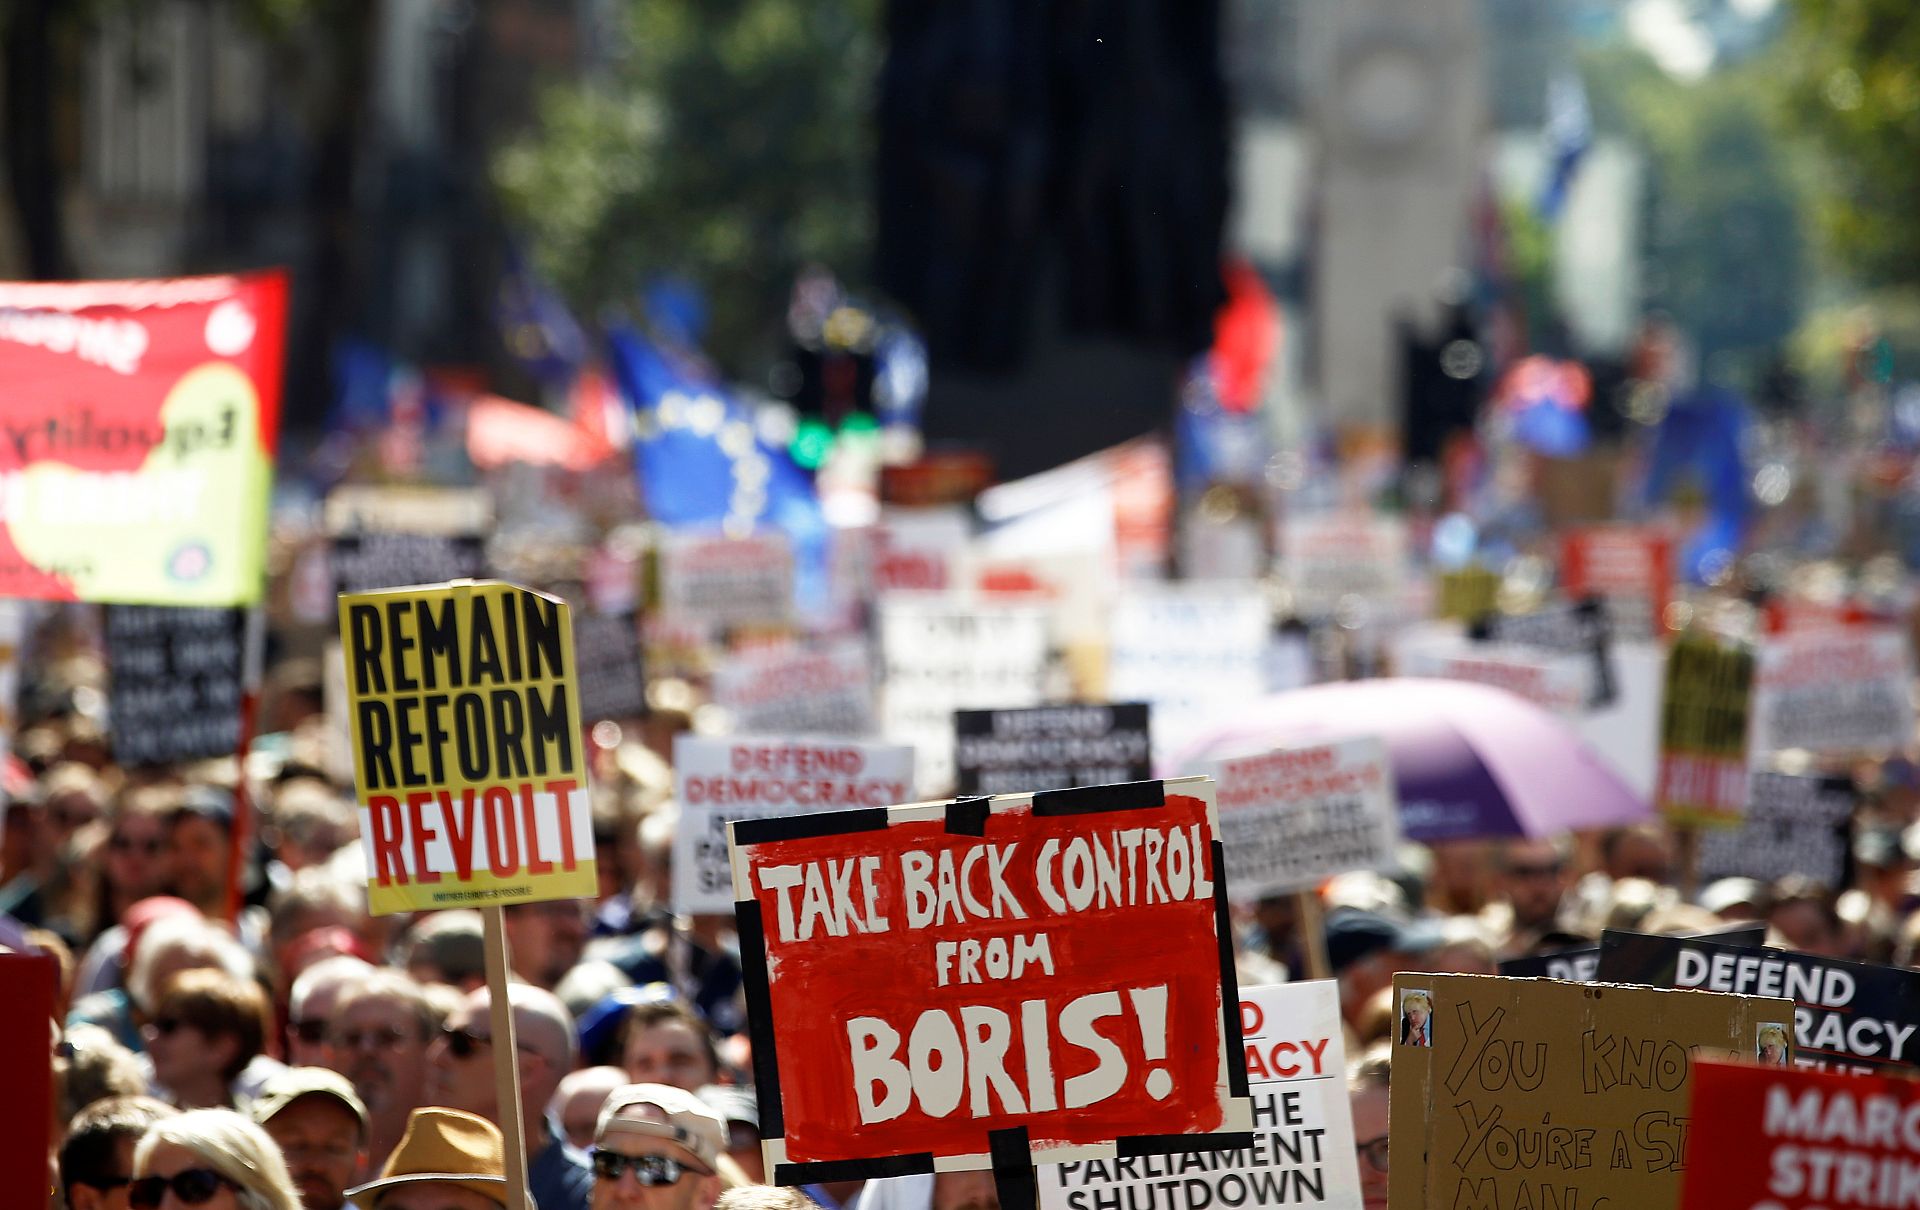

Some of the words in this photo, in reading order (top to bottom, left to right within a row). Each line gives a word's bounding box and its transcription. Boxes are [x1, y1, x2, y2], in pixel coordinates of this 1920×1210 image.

[350, 591, 563, 694] REMAIN
[358, 684, 573, 790] REFORM
[731, 745, 865, 776] DEFEND
[685, 776, 908, 806] DEMOCRACY
[368, 780, 577, 887] REVOLT
[758, 856, 889, 942] TAKE
[901, 843, 1028, 930] BACK
[1037, 823, 1214, 914] CONTROL
[935, 933, 1055, 987] FROM
[1677, 948, 1856, 1008] DEFEND
[846, 984, 1173, 1125] BORIS!
[1444, 1001, 1547, 1096] YOU
[1058, 1129, 1326, 1187] PARLIAMENT
[1453, 1100, 1596, 1172] YOU'RE
[1610, 1130, 1632, 1170] A
[1067, 1168, 1326, 1210] SHUTDOWN
